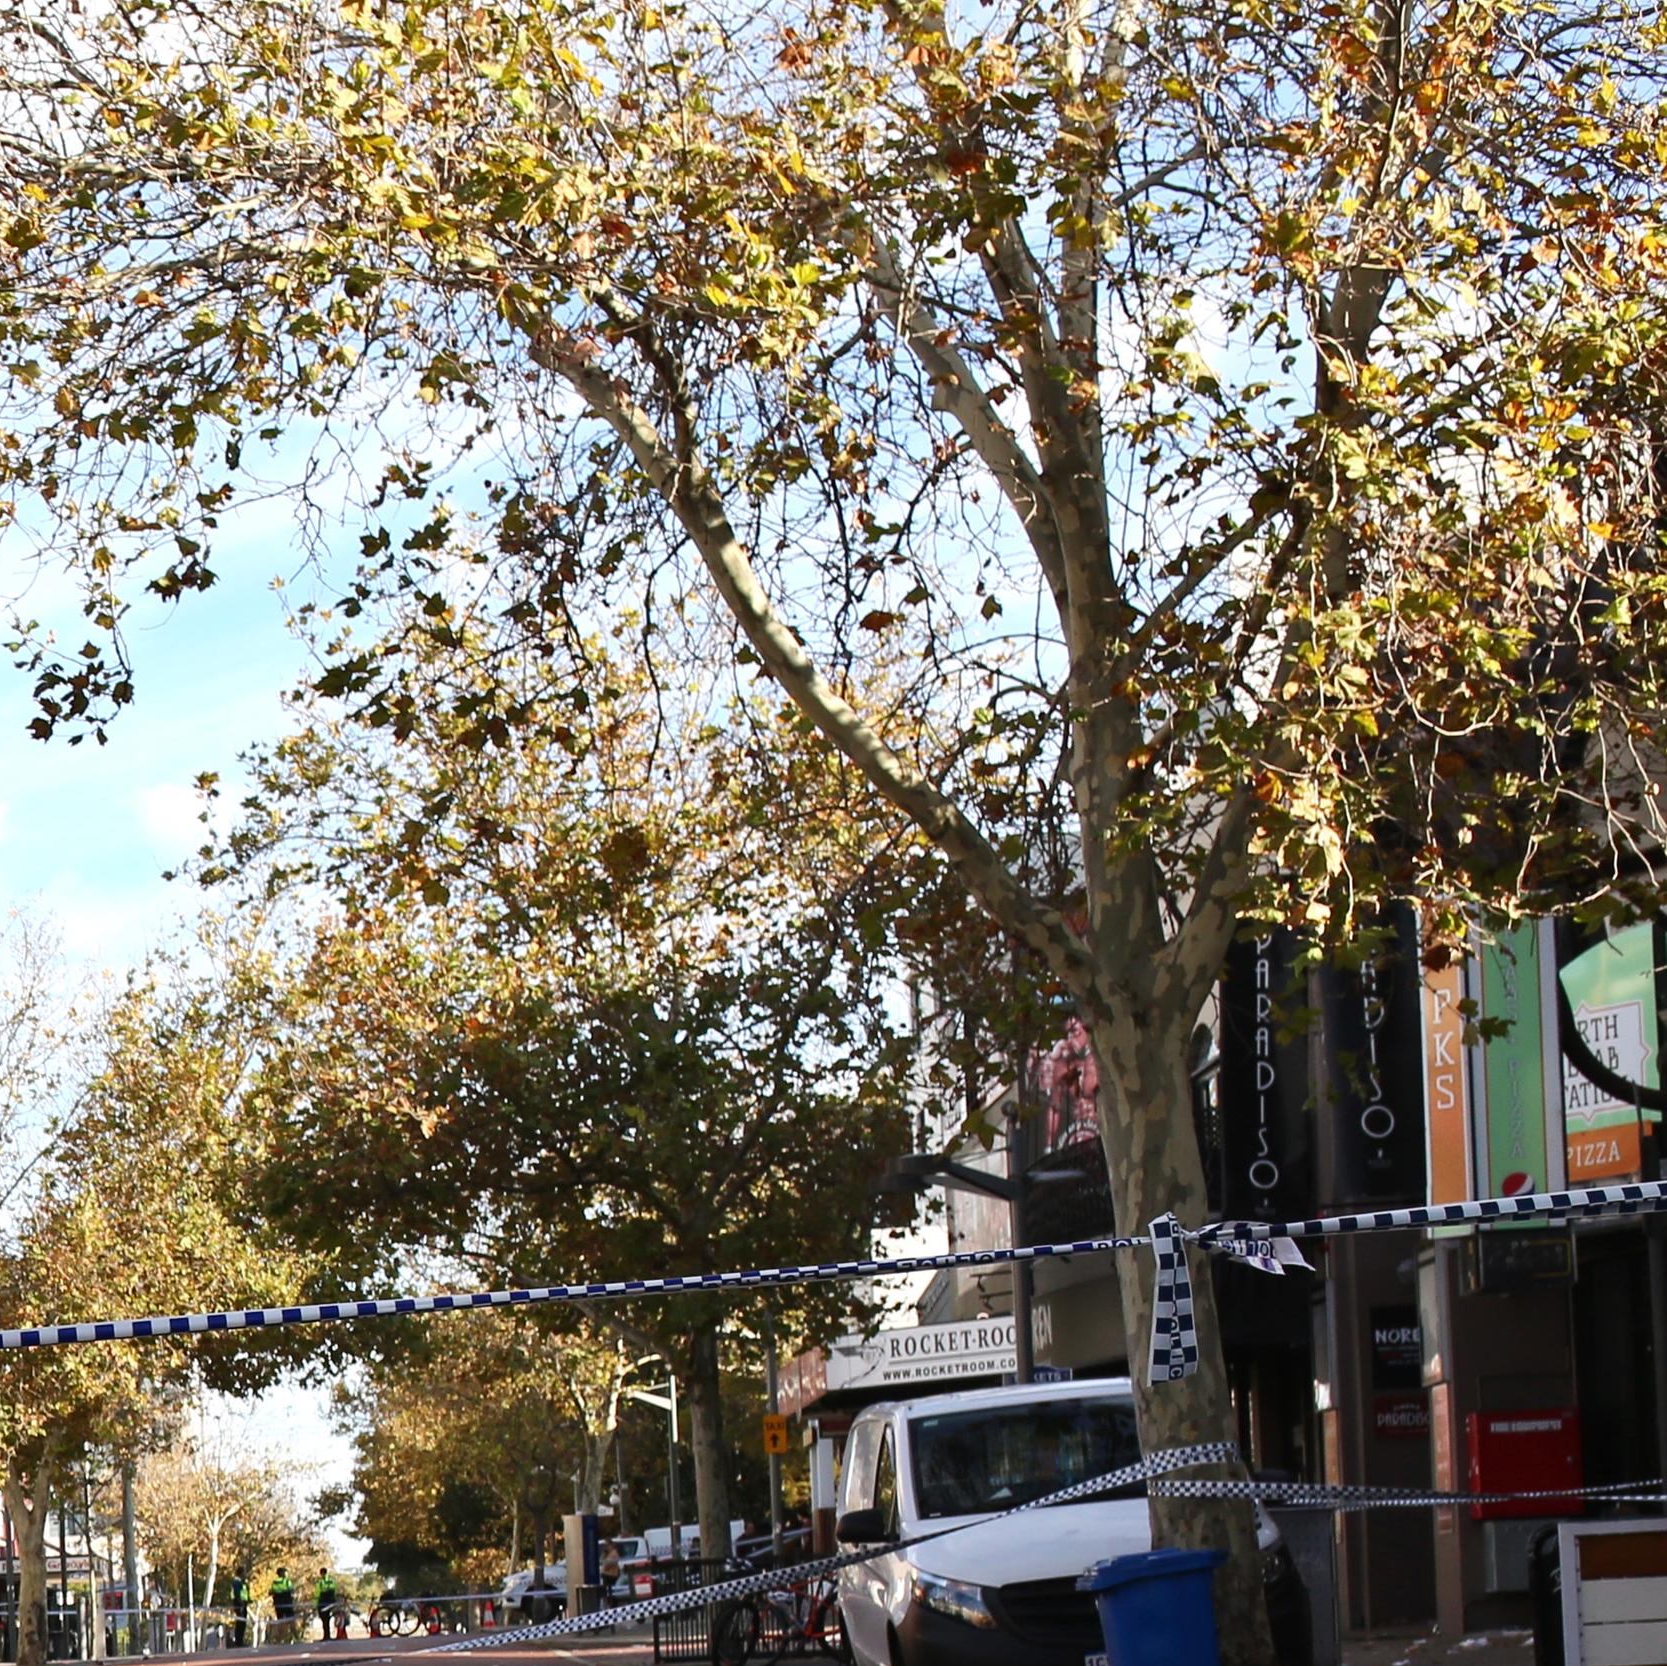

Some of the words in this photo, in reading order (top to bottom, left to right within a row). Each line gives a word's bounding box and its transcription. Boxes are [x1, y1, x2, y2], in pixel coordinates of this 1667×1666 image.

[1433, 989, 1456, 1110] PKS
[1580, 1014, 1619, 1046] RTH
[1508, 1059, 1525, 1159] PIZZA
[882, 1358, 1017, 1381] WWW.ROCKETROOM.CO
